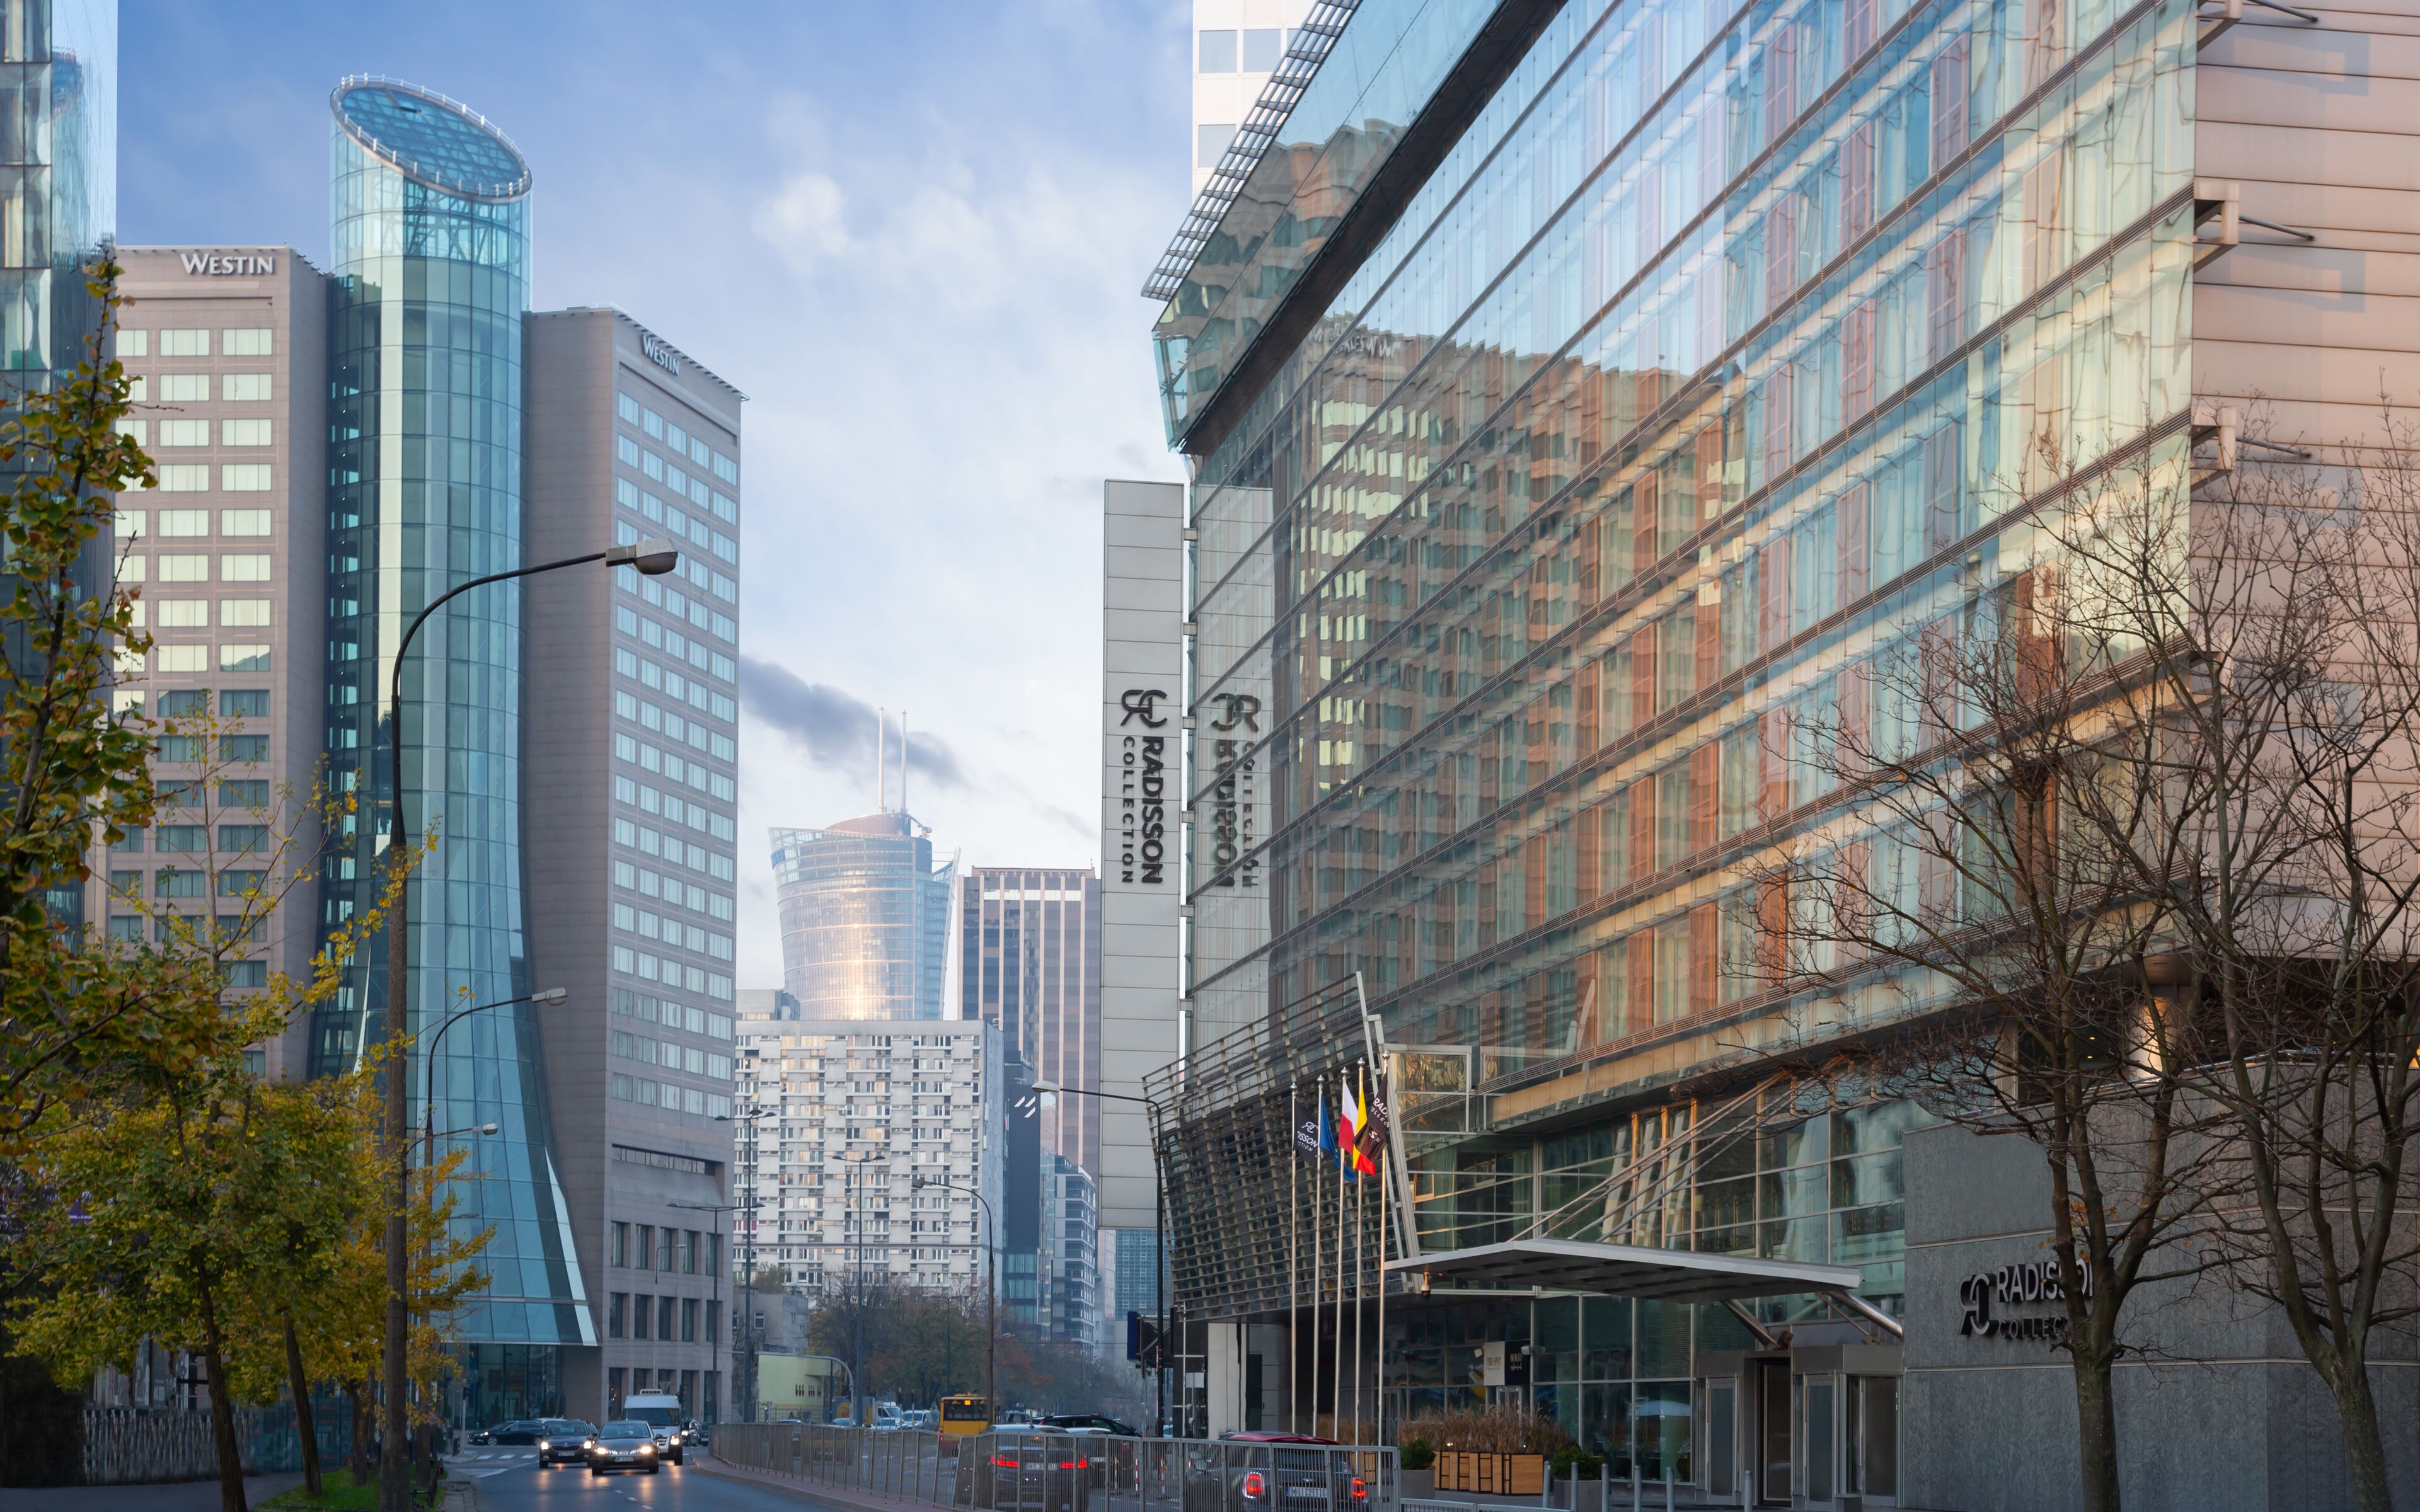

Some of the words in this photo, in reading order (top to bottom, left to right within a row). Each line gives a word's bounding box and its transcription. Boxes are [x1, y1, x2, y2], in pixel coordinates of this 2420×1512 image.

[181, 253, 274, 274] WESTIN
[642, 334, 679, 375] WESTIN
[1122, 736, 1135, 883] COLLECTION
[1141, 736, 1165, 883] RADISSON
